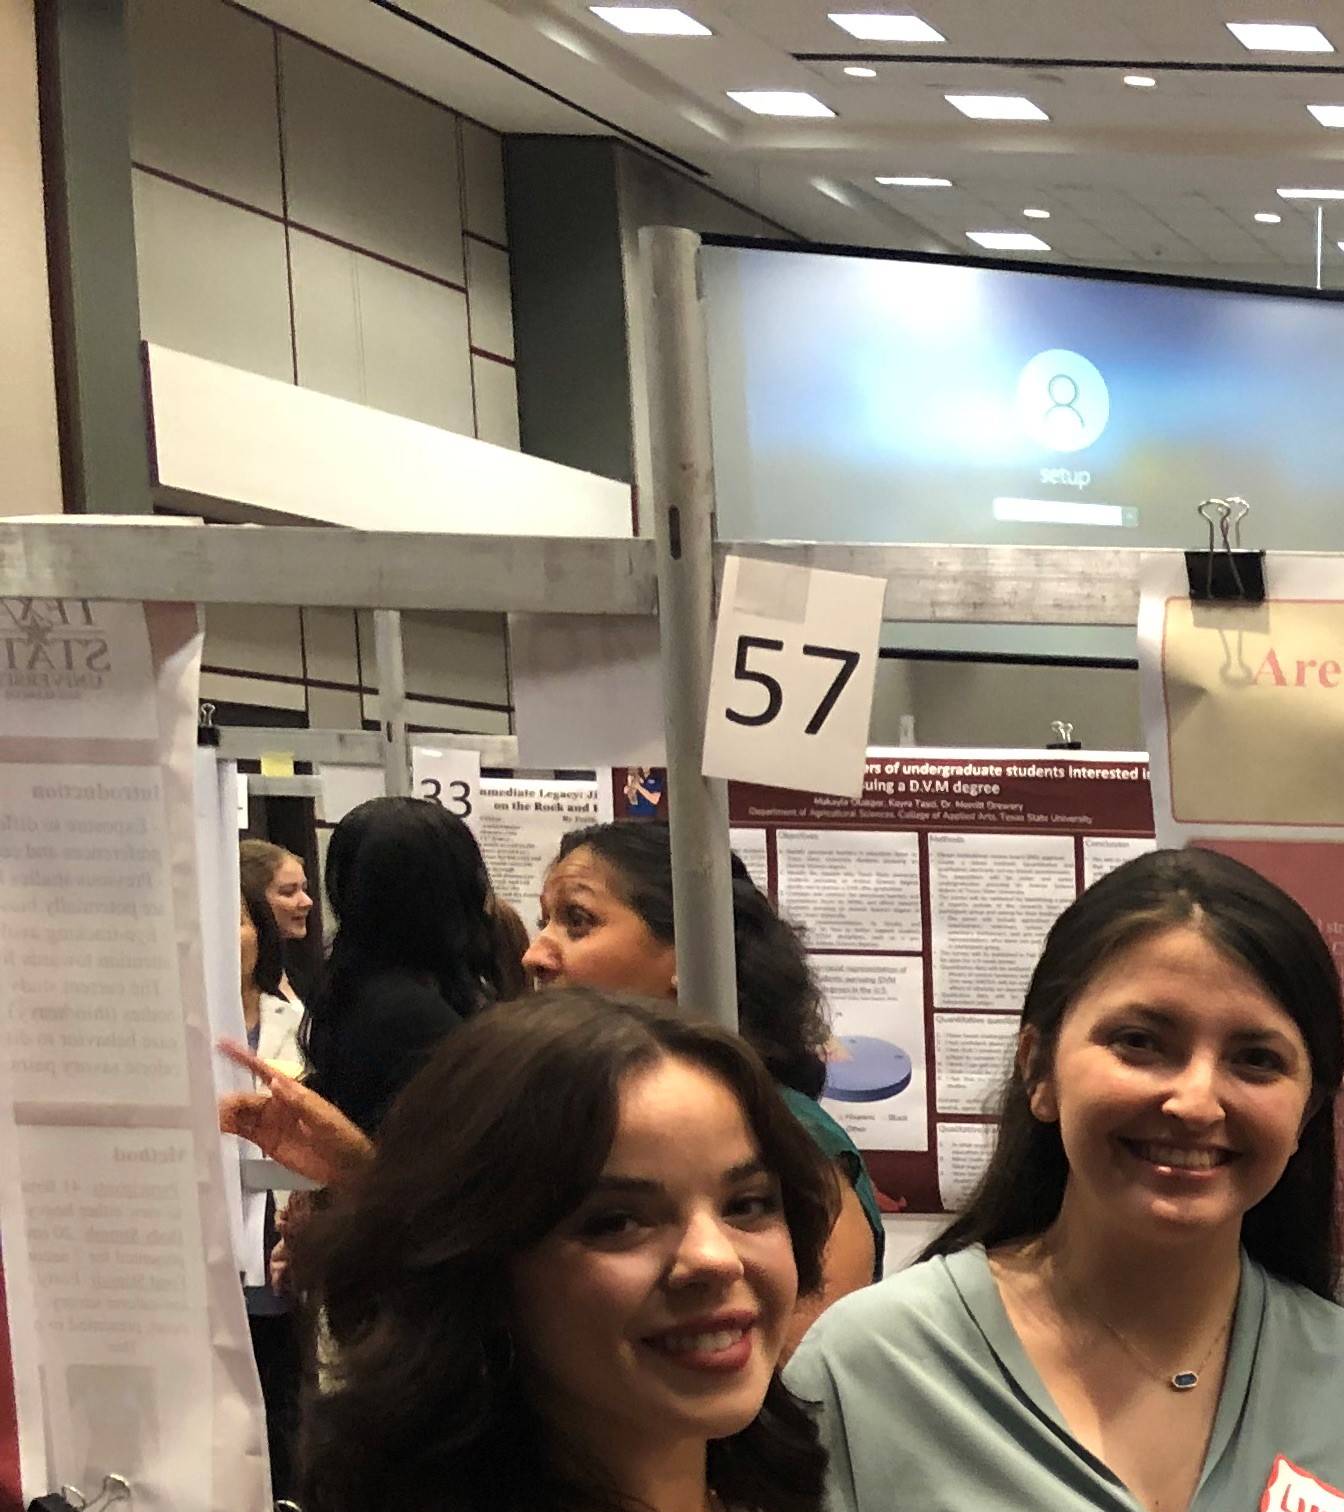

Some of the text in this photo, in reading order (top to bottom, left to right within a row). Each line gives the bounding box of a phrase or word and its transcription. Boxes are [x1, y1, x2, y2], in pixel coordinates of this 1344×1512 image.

[1040, 468, 1091, 490] setup
[1254, 647, 1342, 689] Are
[725, 635, 860, 734] 57
[898, 782, 904, 791] a
[910, 779, 948, 792] D.V.M
[953, 780, 999, 796] degree
